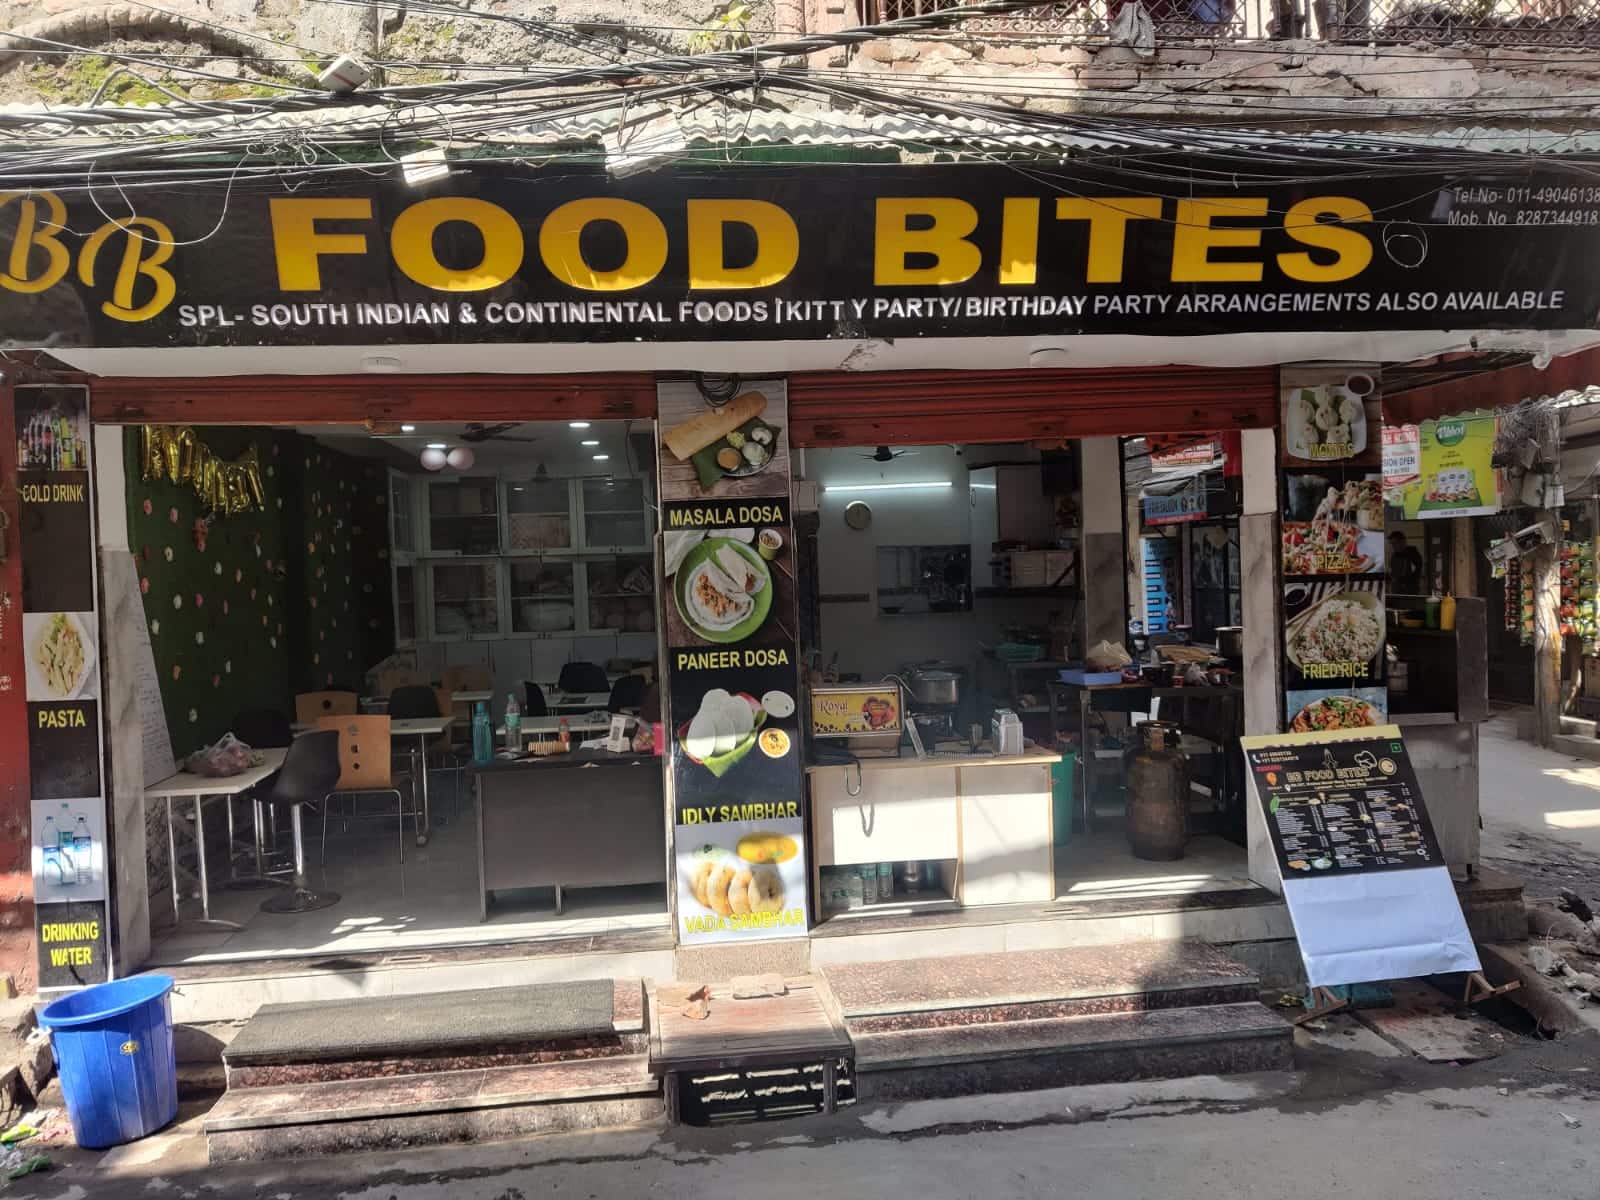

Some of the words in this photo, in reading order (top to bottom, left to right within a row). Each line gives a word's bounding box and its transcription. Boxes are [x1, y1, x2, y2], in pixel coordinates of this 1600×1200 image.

[1516, 209, 1599, 226] 8287344918
[268, 196, 800, 292] FOOD
[873, 195, 1375, 287] BITES
[178, 304, 244, 327] SPL-
[252, 303, 349, 326] SOUTH
[356, 302, 451, 325] INDIAN
[459, 302, 478, 324] &
[485, 301, 672, 324] CONTINENTAL
[679, 300, 769, 323] FOODS
[1094, 294, 1172, 315] PARTY
[1176, 293, 1372, 313] ARRANGEMENTS
[1376, 291, 1438, 312] ALSO
[1442, 290, 1566, 311] AVAILABLE
[22, 484, 50, 503] COLD
[53, 484, 84, 503] DRINK
[670, 507, 735, 527] MASALA
[739, 504, 784, 523] DOSA
[1315, 553, 1351, 570] PIZZA
[677, 650, 740, 671] PANEER
[744, 649, 789, 667] DOSA
[38, 709, 86, 729] PASTA
[682, 806, 716, 825] IDLY
[720, 801, 798, 822] SAMBHAR
[42, 920, 99, 943] DRINKING
[684, 914, 727, 934] VADA
[729, 908, 804, 931] SAMBHAR
[50, 946, 92, 968] WATER
